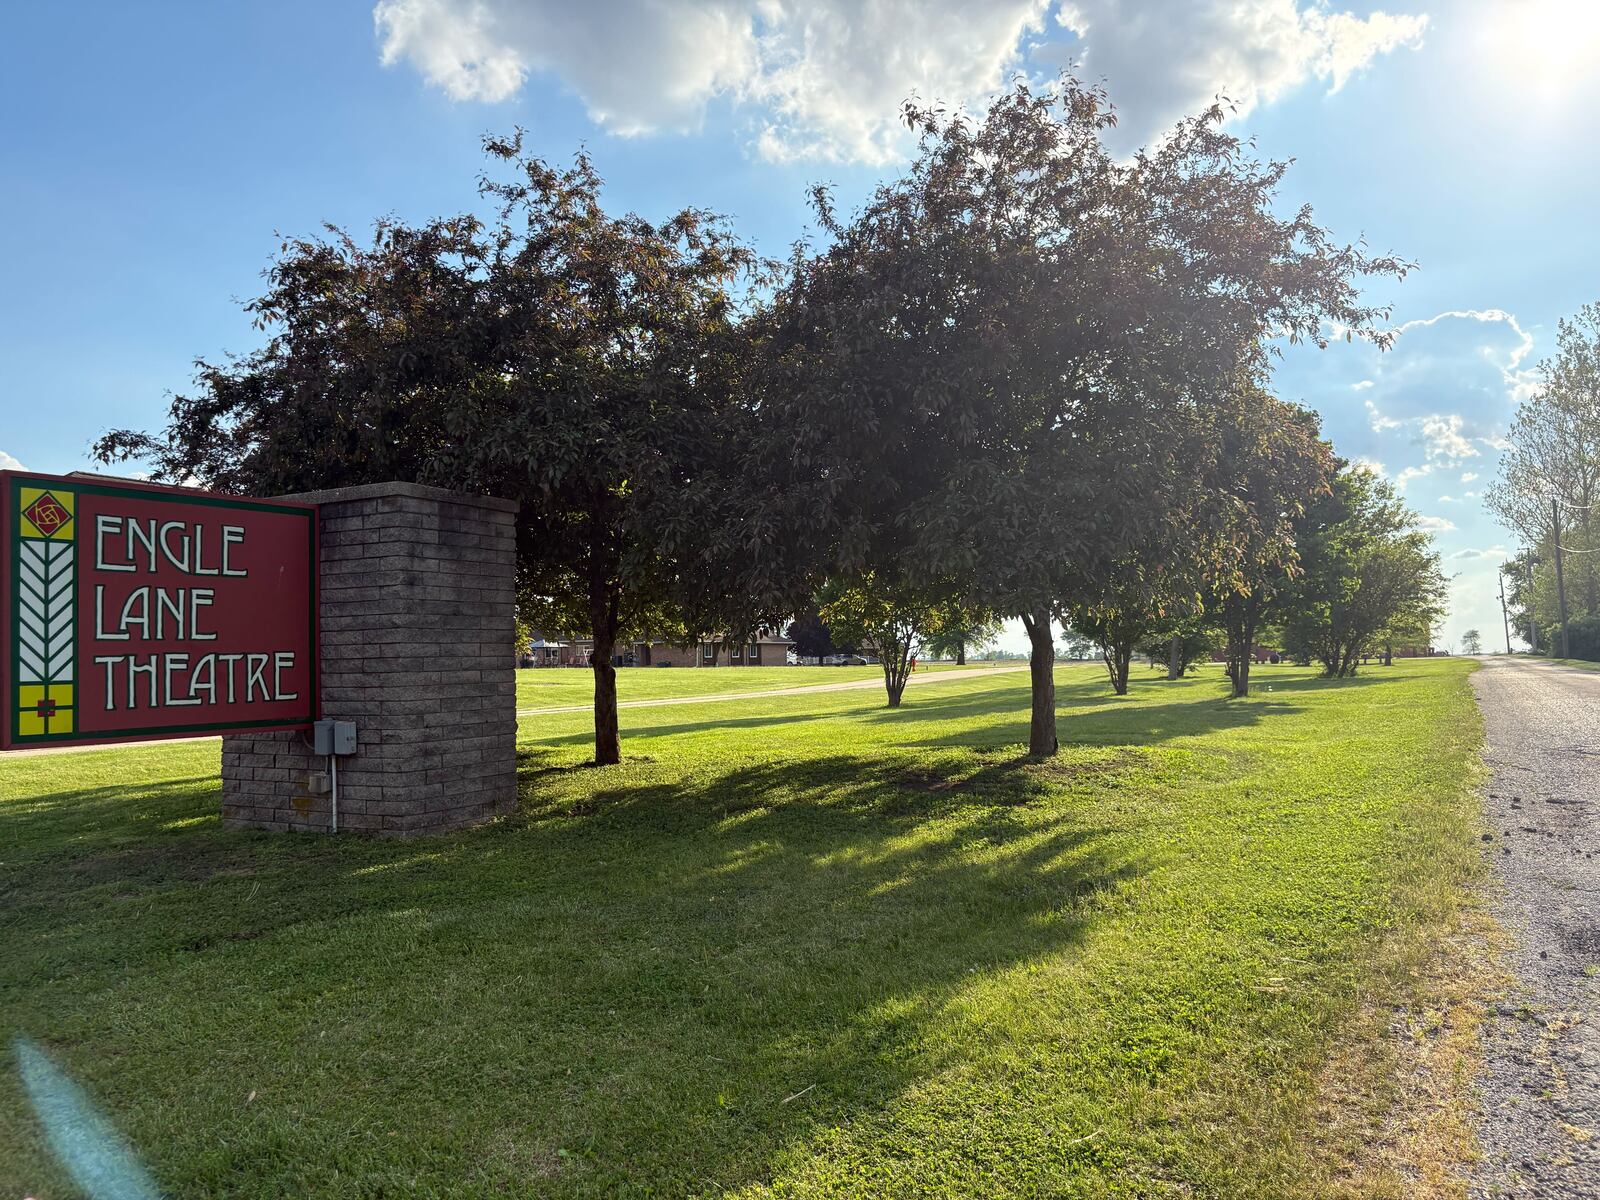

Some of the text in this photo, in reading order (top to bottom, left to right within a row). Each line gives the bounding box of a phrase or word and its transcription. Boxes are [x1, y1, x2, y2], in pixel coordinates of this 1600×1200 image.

[95, 515, 247, 577] ENGLE
[95, 585, 217, 640] LANE
[94, 652, 298, 711] THEATRE
